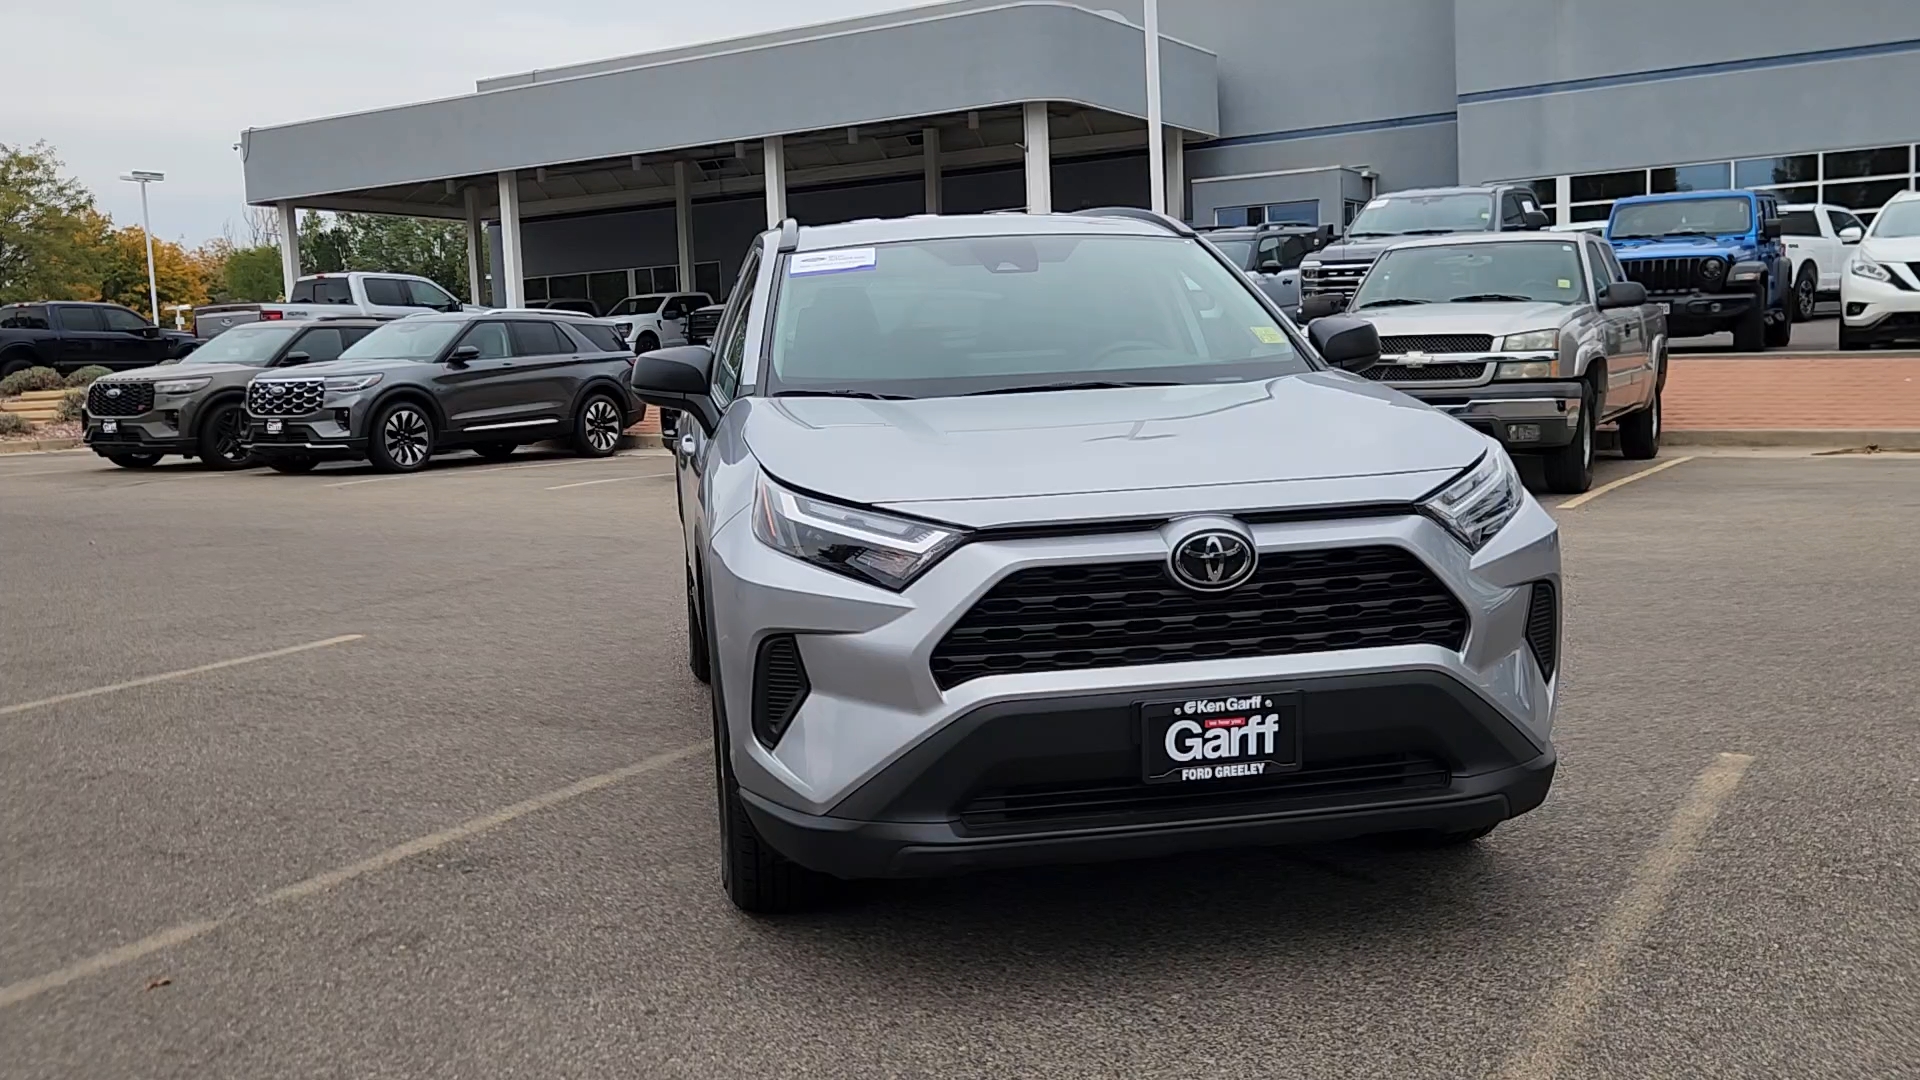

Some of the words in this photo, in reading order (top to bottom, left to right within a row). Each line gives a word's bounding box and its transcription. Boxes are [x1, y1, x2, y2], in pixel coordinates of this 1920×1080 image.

[1197, 699, 1226, 714] Ken
[1226, 695, 1262, 711] Garff
[1164, 713, 1279, 762] Garff
[1182, 767, 1213, 781] FORD
[1214, 762, 1265, 779] GREELEY
